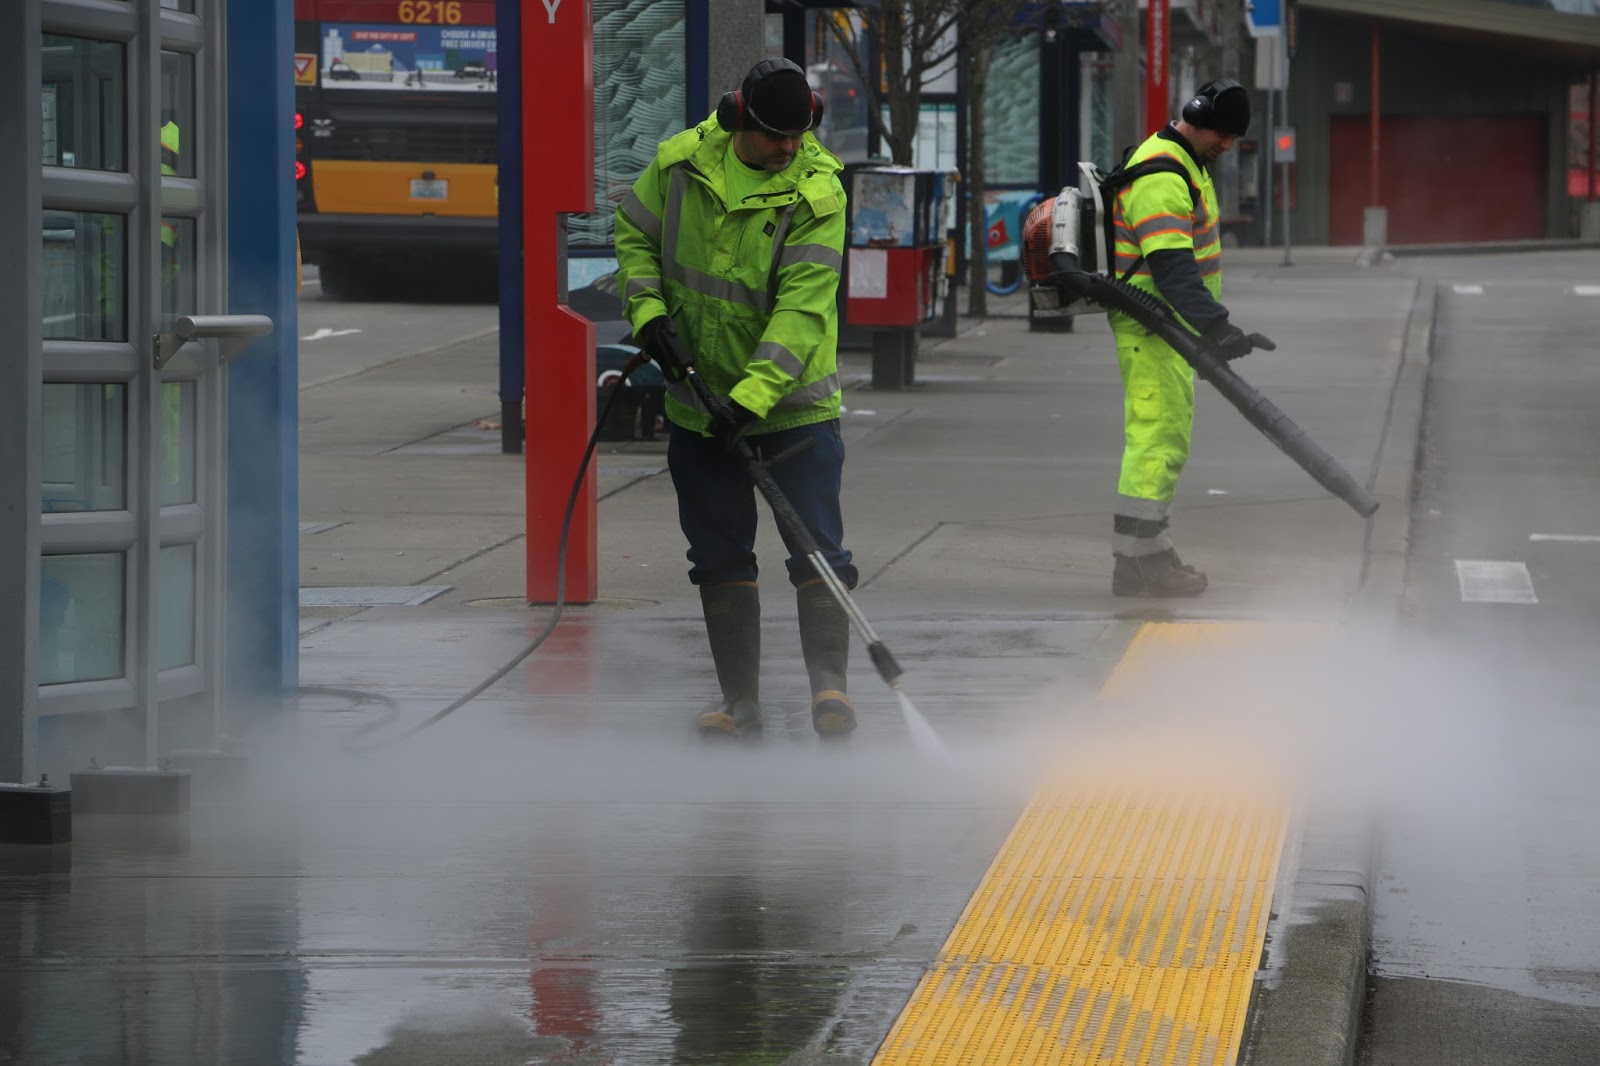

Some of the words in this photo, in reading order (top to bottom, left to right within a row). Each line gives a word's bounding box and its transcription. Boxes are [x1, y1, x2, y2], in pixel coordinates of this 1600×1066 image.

[399, 0, 462, 25] 6216
[541, 0, 561, 24] Y
[440, 30, 470, 39] CHOOSE
